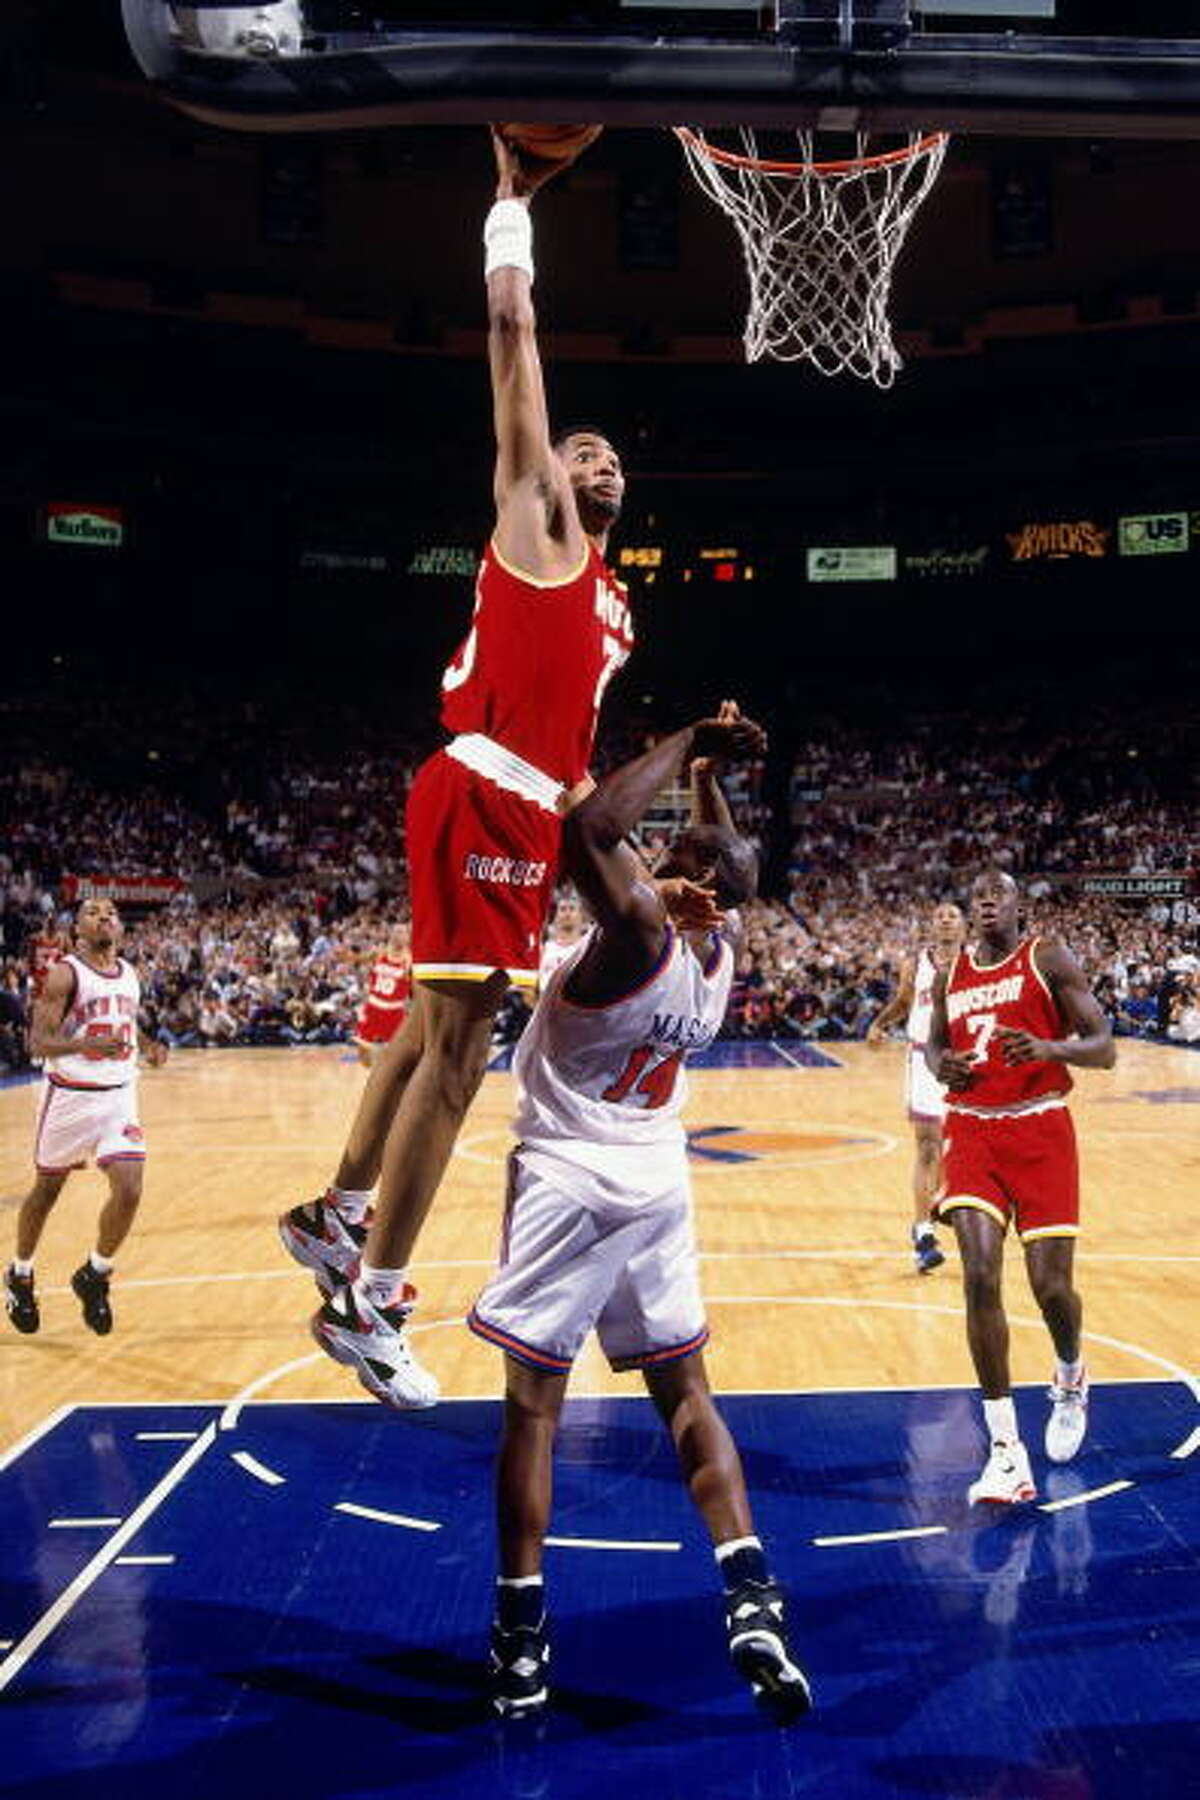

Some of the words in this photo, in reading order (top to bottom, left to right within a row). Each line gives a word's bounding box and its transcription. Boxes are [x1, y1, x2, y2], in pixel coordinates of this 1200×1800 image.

[1005, 521, 1108, 561] KNICKS
[1126, 880, 1183, 893] LIGHT
[966, 1013, 998, 1068] 7
